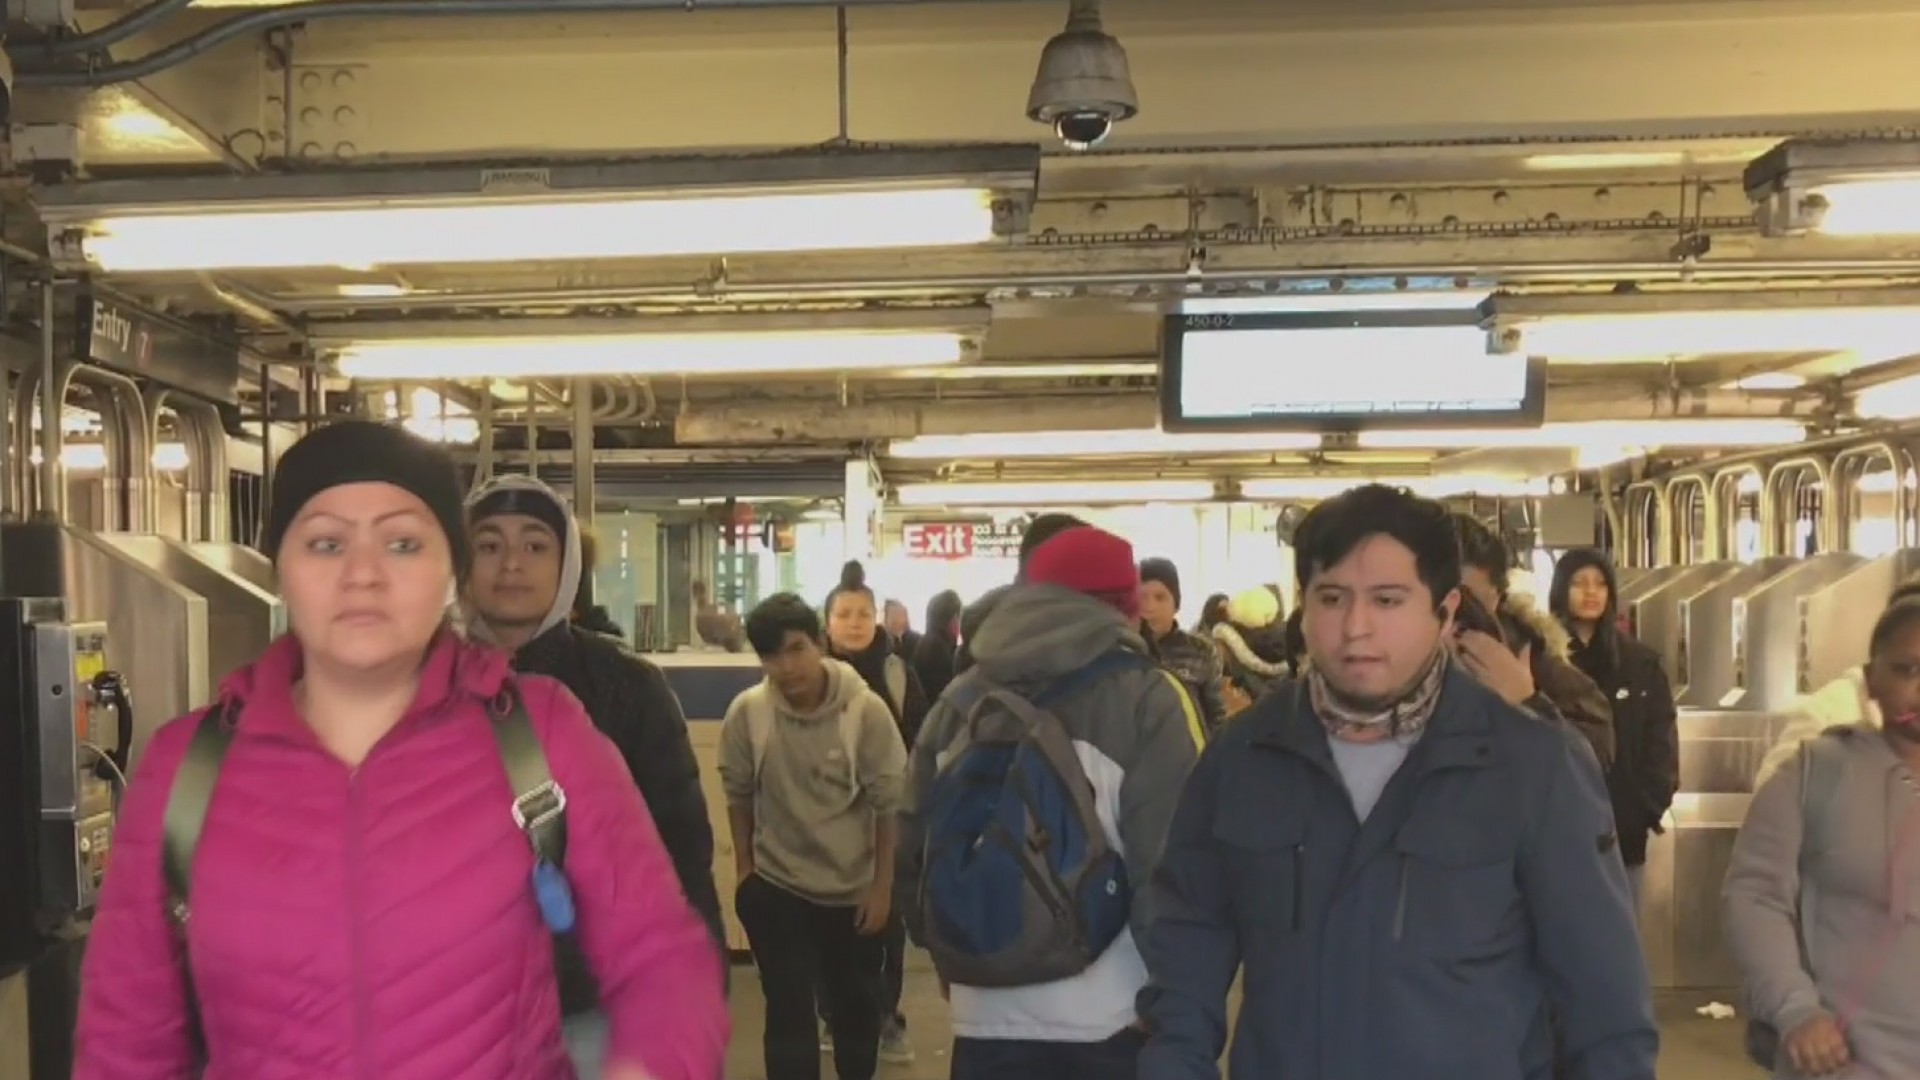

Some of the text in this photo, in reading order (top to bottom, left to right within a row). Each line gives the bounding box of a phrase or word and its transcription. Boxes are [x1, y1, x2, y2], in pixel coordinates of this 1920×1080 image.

[92, 299, 149, 358] Entry 7
[904, 524, 967, 554] Exit
